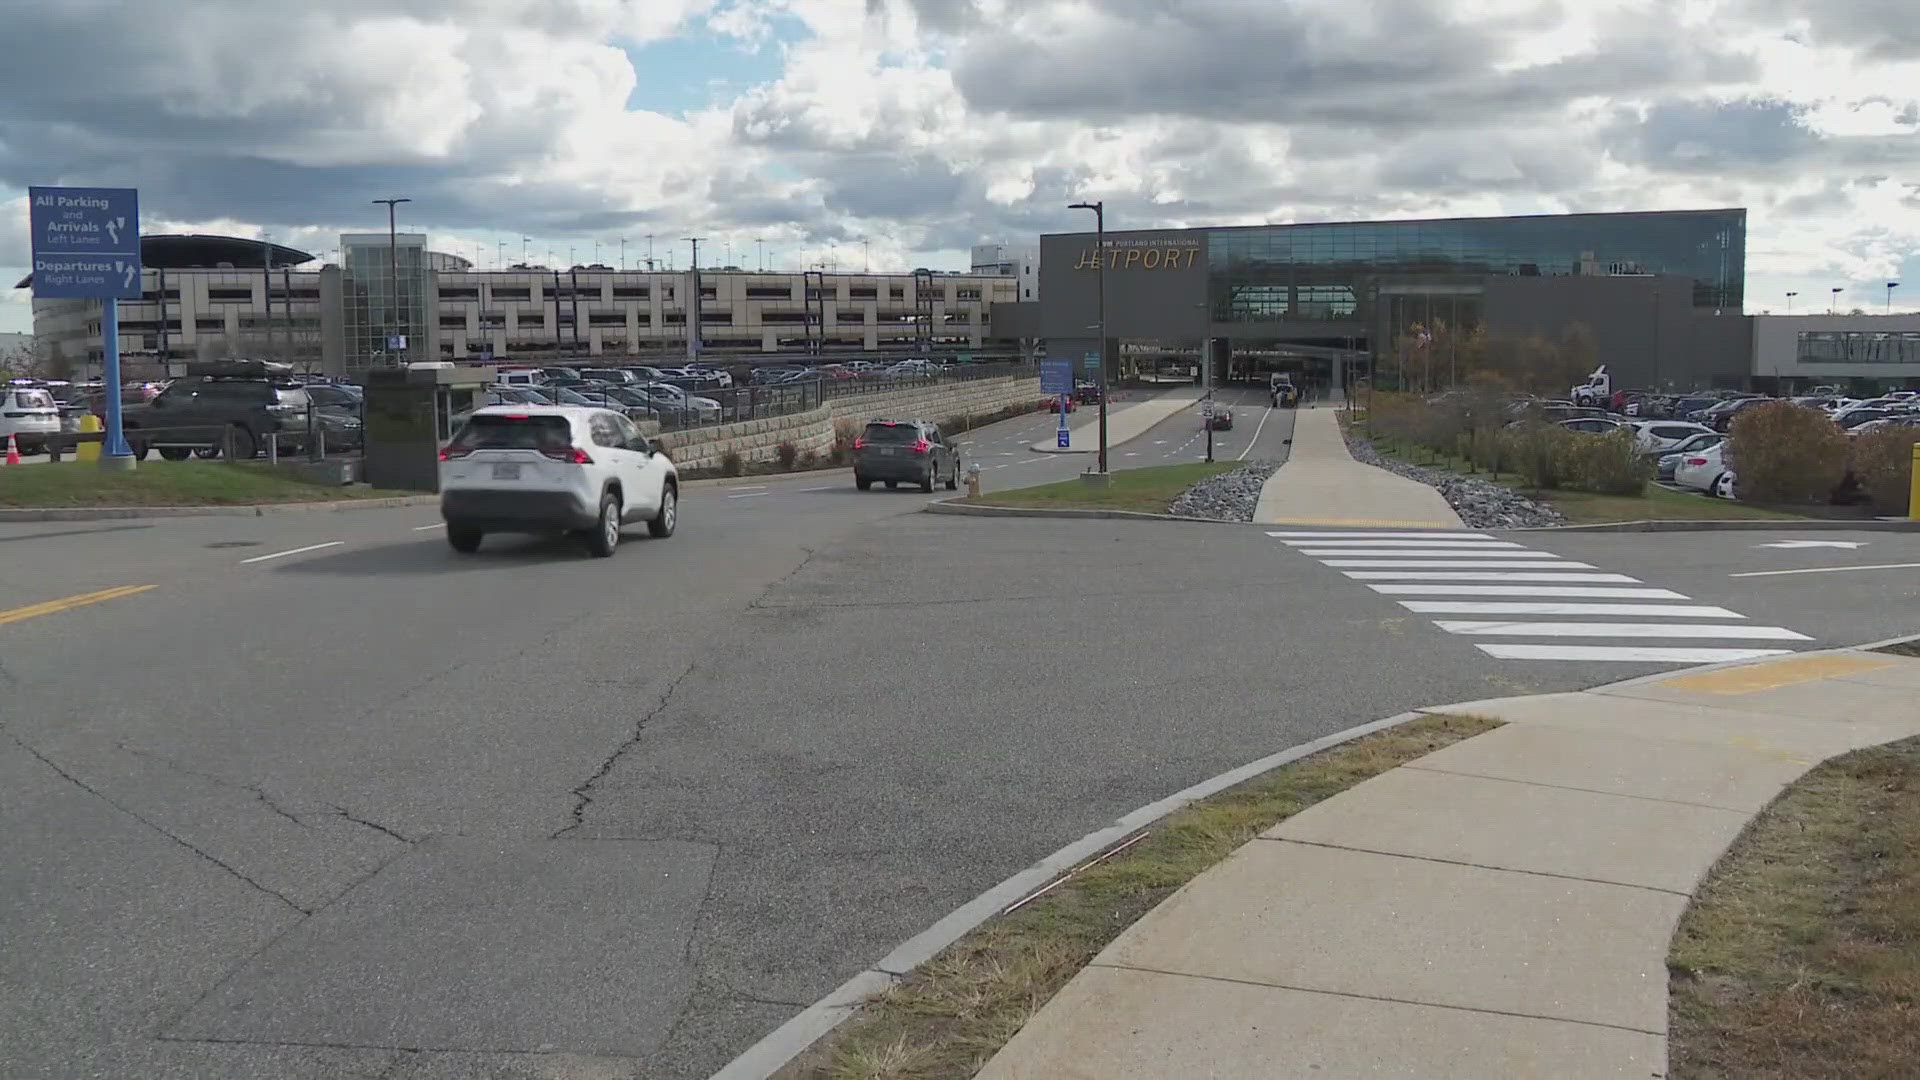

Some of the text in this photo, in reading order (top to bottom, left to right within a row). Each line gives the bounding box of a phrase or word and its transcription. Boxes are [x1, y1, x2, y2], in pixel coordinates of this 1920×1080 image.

[35, 196, 109, 210] All Parking
[63, 211, 84, 220] and
[48, 221, 99, 232] Arrivals
[47, 234, 100, 244] Left Lanes
[1074, 248, 1200, 269] JETPORT
[35, 260, 112, 273] Departures
[45, 274, 104, 285] Right Lanes
